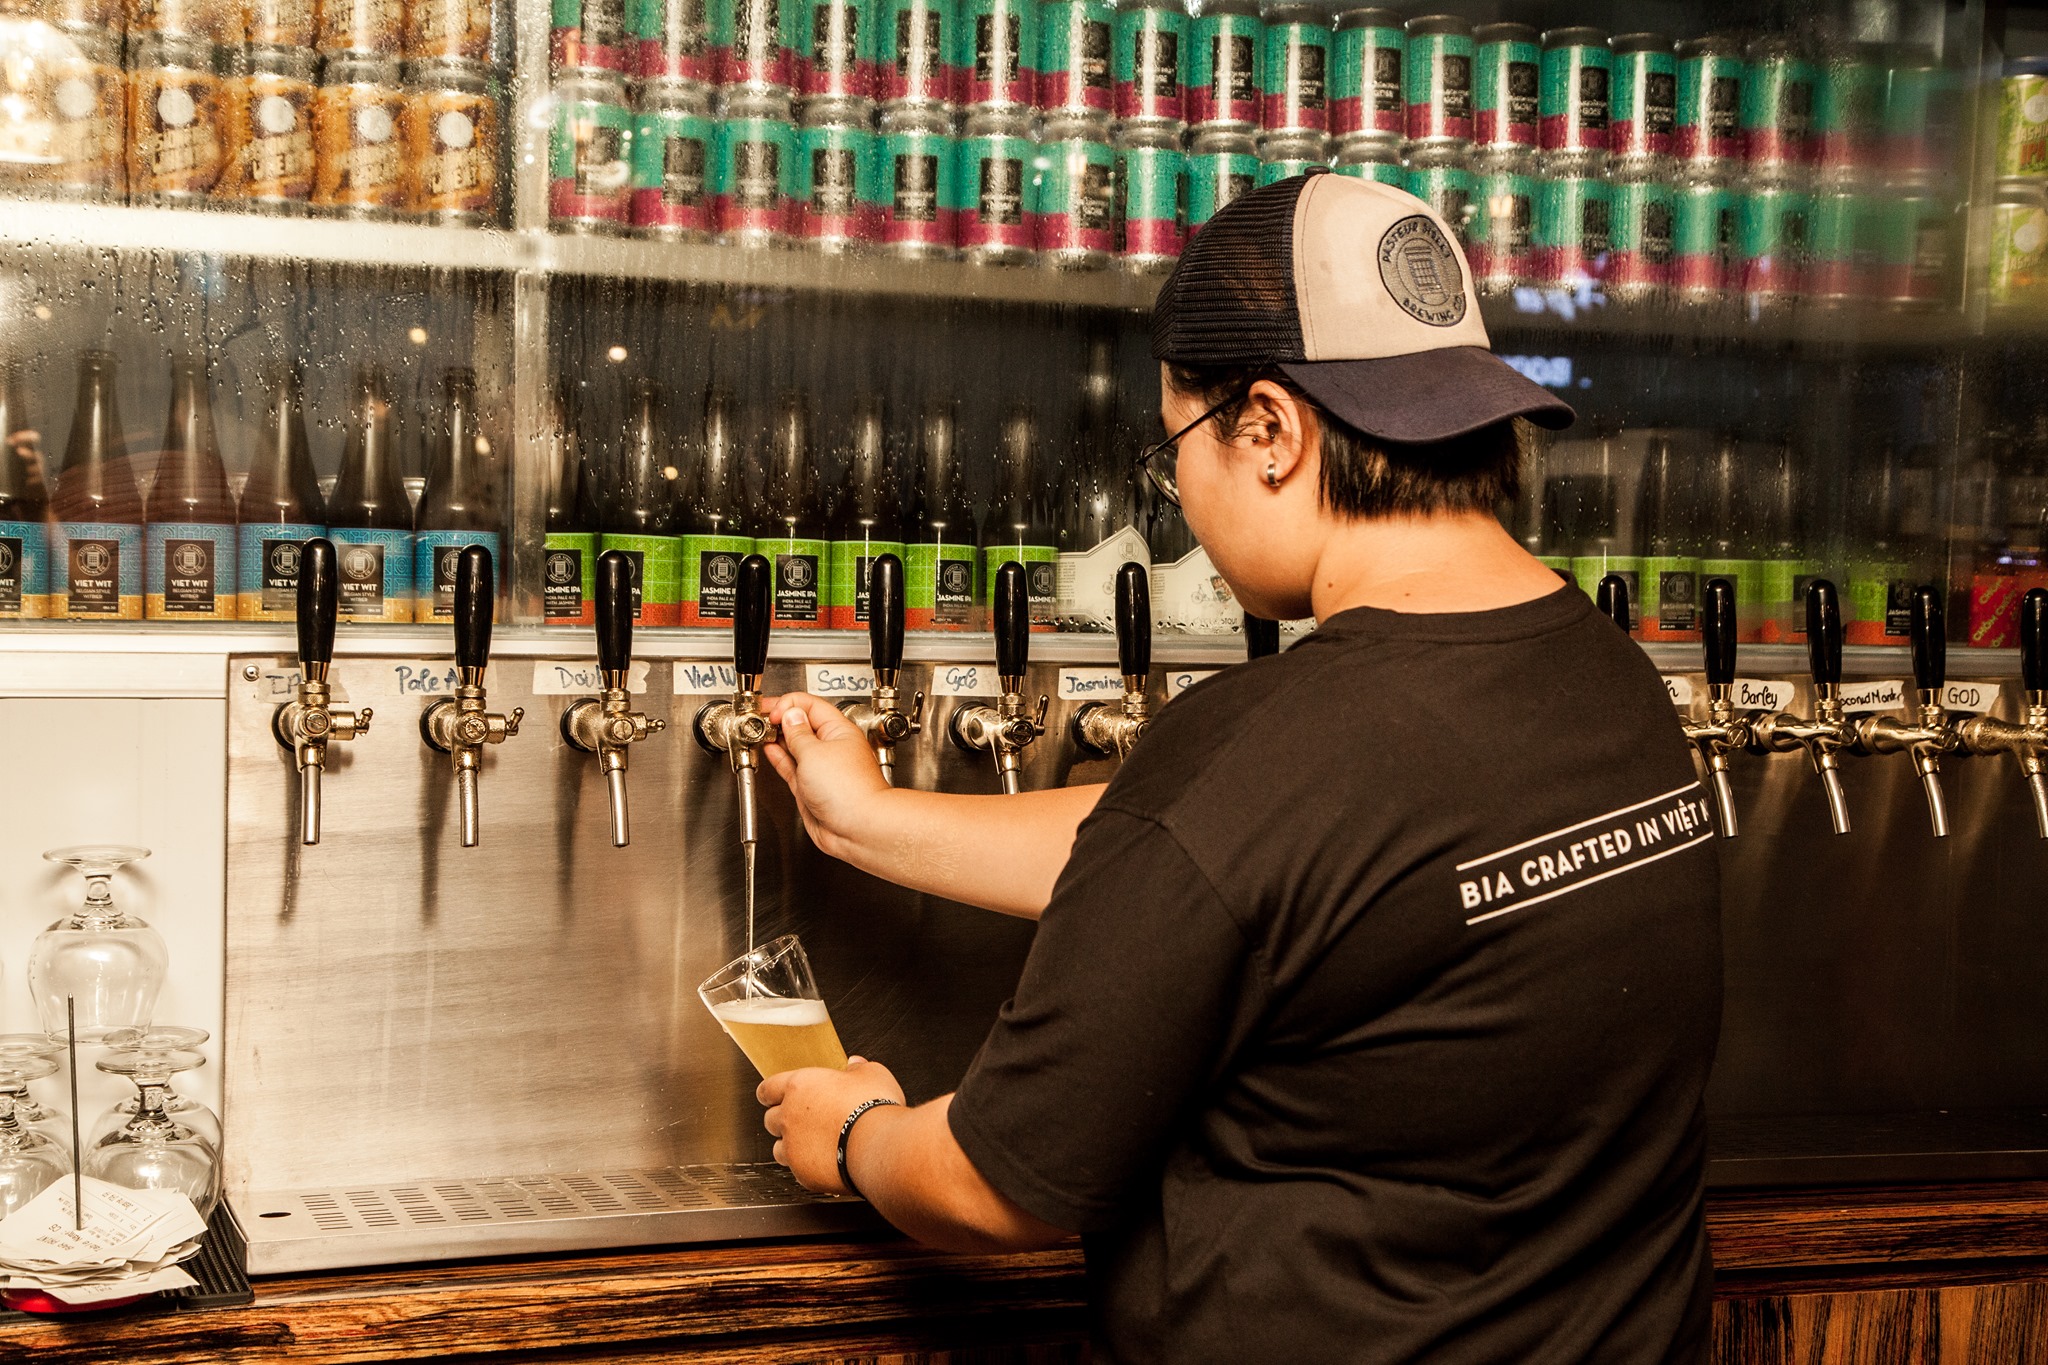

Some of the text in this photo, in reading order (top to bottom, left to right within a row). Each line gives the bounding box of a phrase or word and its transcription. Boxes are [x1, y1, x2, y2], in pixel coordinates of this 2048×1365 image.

[1383, 222, 1418, 263] PASTEUR
[1402, 298, 1456, 322] BREWING
[777, 590, 806, 598] JASMINE
[395, 665, 440, 694] Pale
[946, 667, 977, 690] Cyclo
[1066, 675, 1124, 693] Jasmine
[1741, 683, 1778, 709] Barley
[1948, 687, 1980, 706] GOD
[1459, 870, 1515, 909] BIA
[1521, 828, 1632, 887] CRAFTED
[1635, 817, 1662, 847] IN
[1662, 798, 1699, 837] VIỆT
